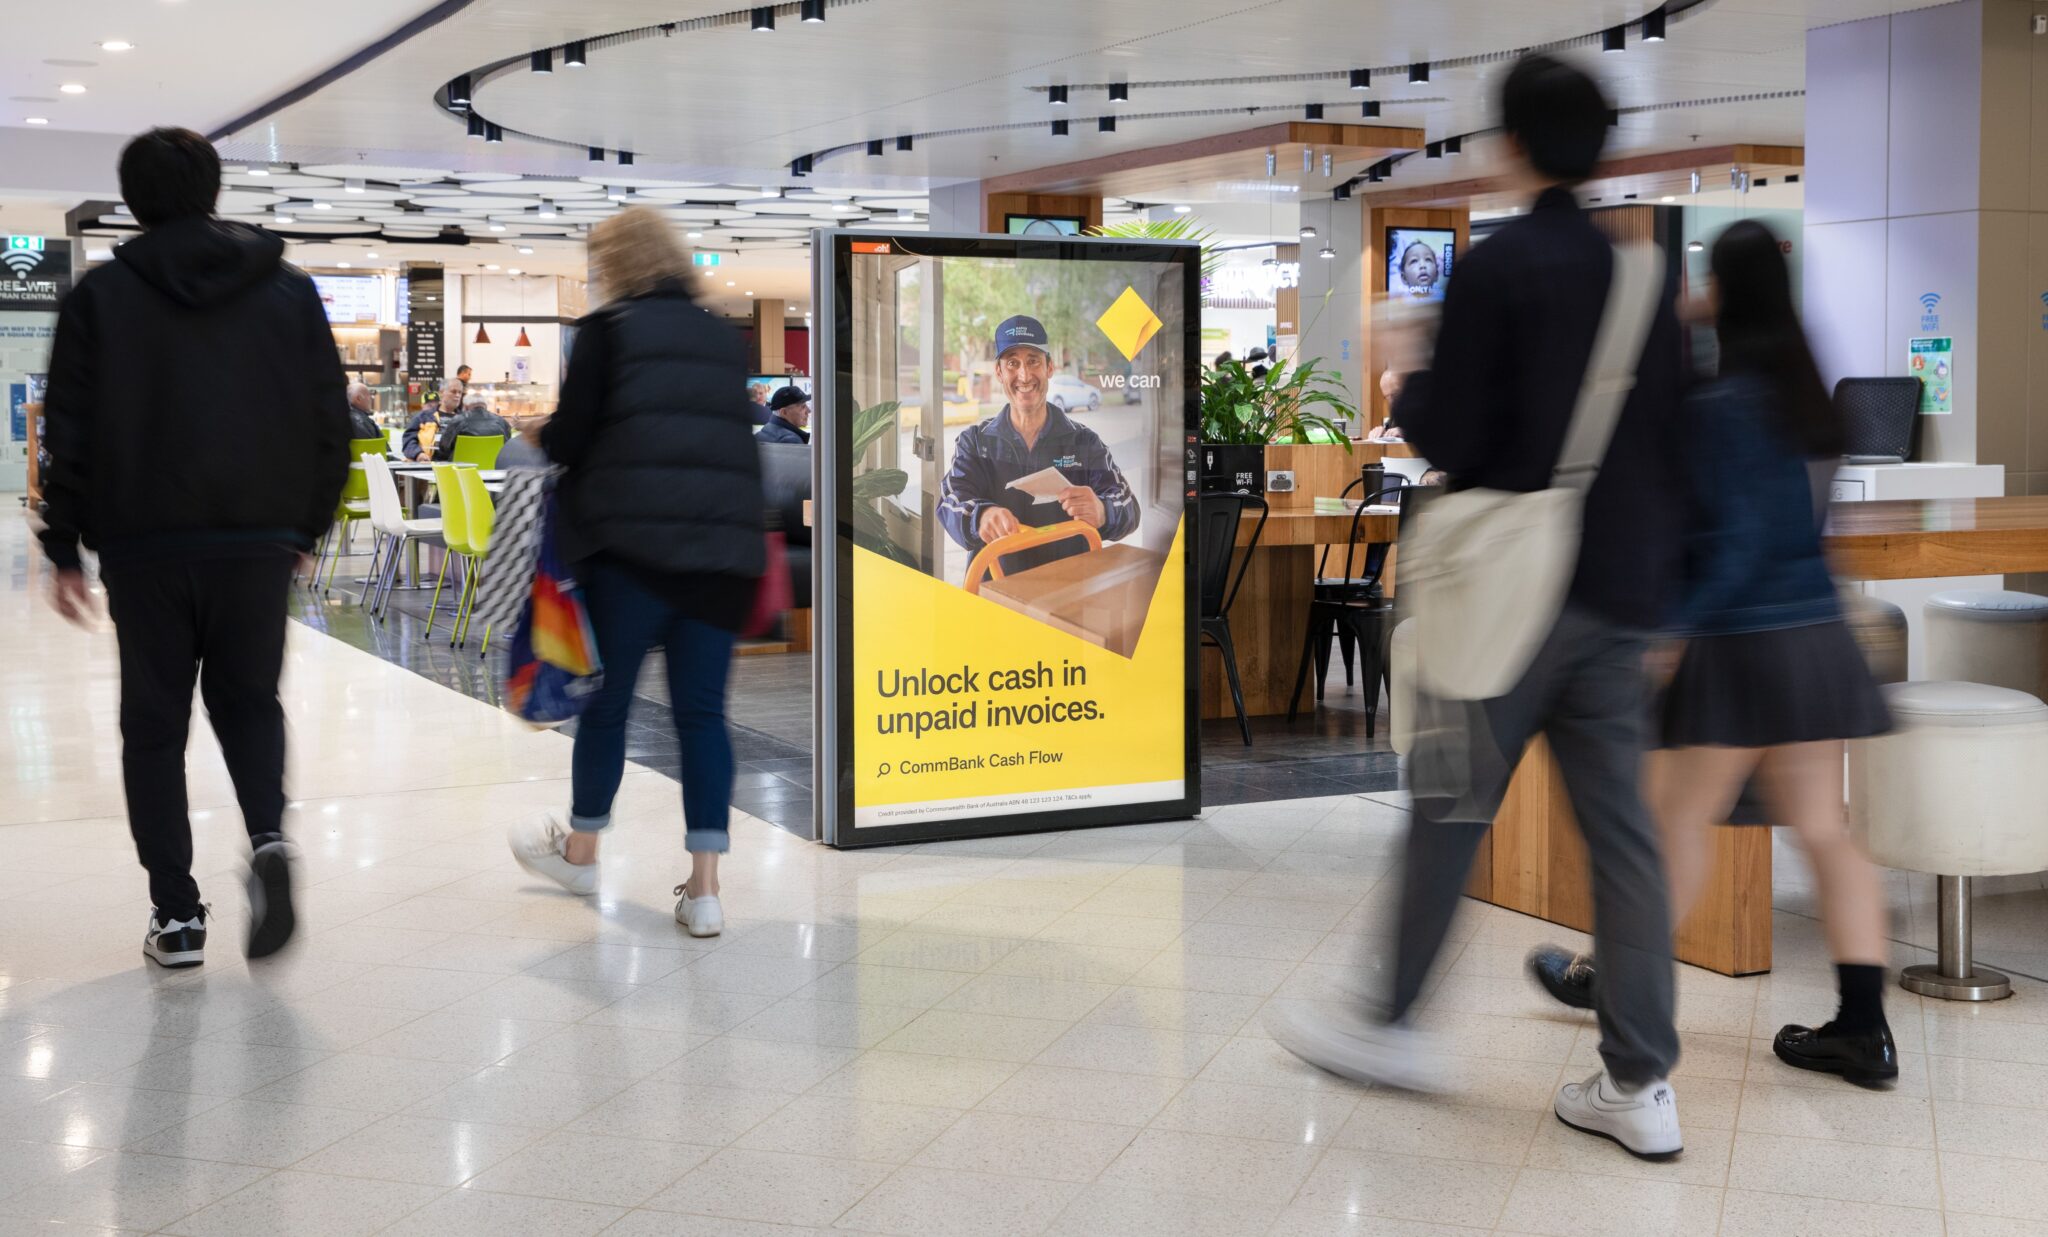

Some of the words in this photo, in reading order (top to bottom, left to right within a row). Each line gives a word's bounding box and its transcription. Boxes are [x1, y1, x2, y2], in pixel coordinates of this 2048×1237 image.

[21, 293, 56, 301] CENTRAL
[1921, 314, 1940, 323] FREE
[1098, 374, 1125, 388] we
[1129, 374, 1161, 388] can
[877, 665, 980, 698] Unlock
[988, 661, 1053, 691] cash
[1063, 659, 1087, 686] in
[877, 700, 977, 739] unpaid
[987, 696, 1105, 727] invoices.
[899, 755, 985, 775] CommBank
[989, 752, 1025, 768] Cash
[1029, 750, 1063, 765] Flow
[895, 808, 918, 817] provided
[925, 804, 966, 813] Commonwealth
[986, 800, 1008, 808] Australia
